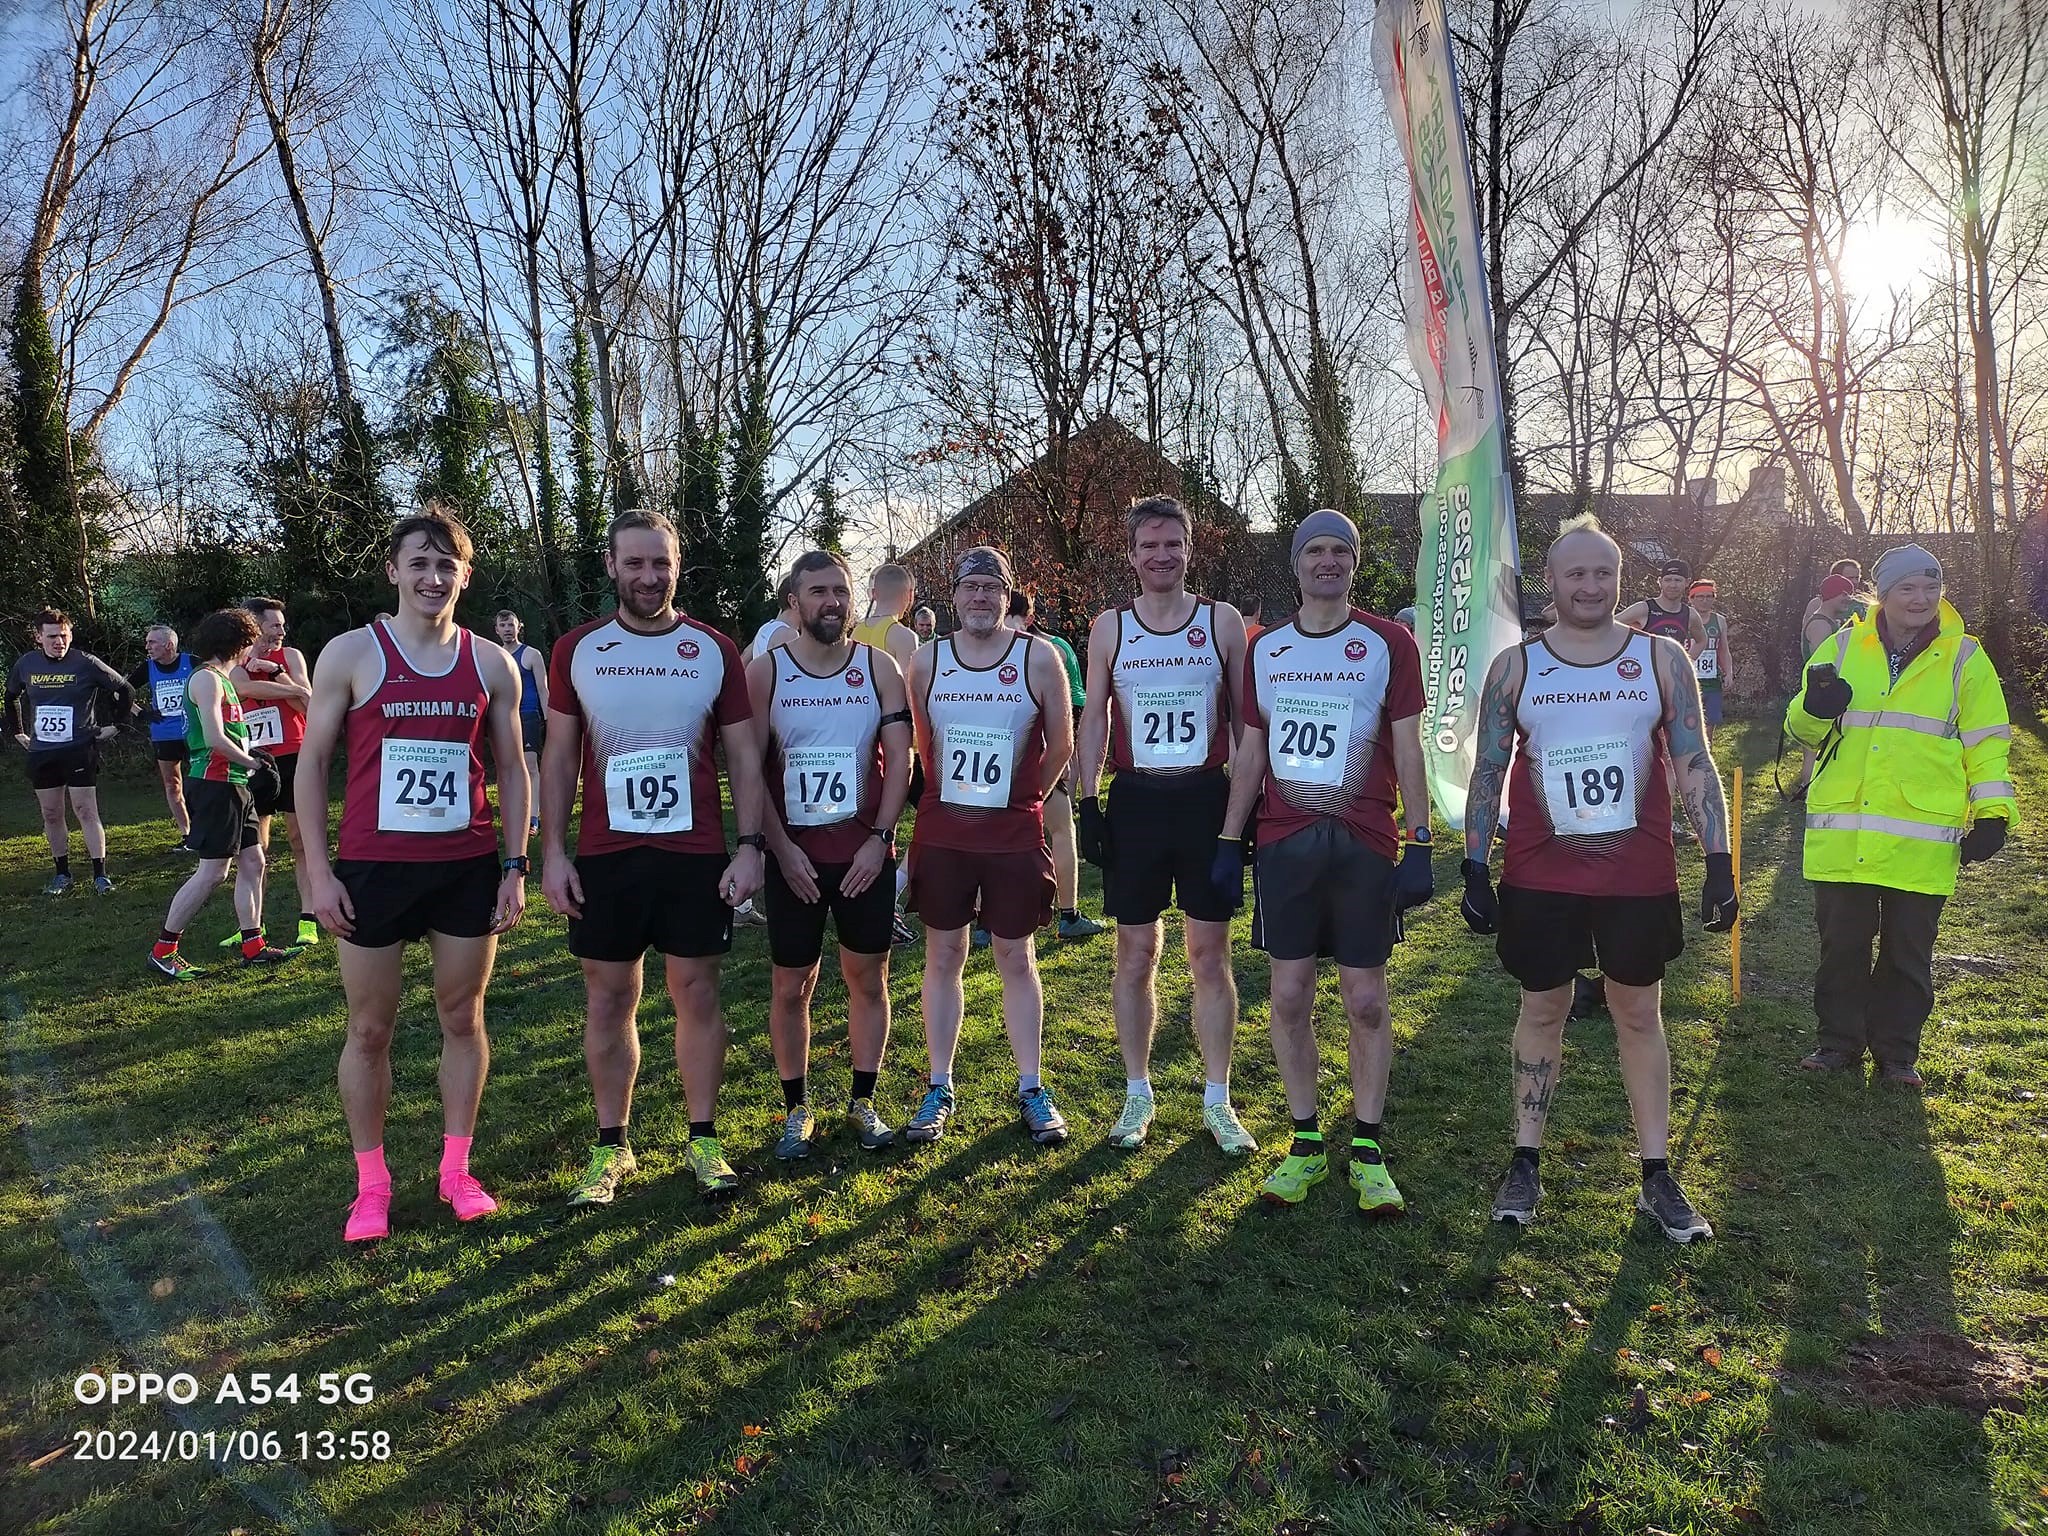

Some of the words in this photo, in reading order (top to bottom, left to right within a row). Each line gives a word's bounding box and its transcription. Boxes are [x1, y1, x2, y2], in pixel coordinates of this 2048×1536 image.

[1122, 657, 1184, 670] WREXHAM
[1187, 656, 1213, 666] AAC
[31, 674, 76, 684] RUN-FREE
[595, 666, 666, 677] WREXHAM
[670, 667, 699, 679] AAC
[1269, 672, 1333, 683] WREXHAM
[1337, 672, 1366, 682] AAC
[781, 697, 842, 708] WREXHAM
[845, 695, 870, 705] AAC
[934, 693, 993, 702] WREXHAM
[997, 693, 1022, 703] AAC
[1137, 691, 1175, 699] GRAND
[1532, 690, 1611, 706] WREXHAM
[1616, 690, 1648, 702] AAC
[381, 701, 453, 718] WREXHAM
[1137, 699, 1186, 707] EXPRESS
[1277, 697, 1318, 707] GRAND
[1321, 702, 1349, 710] PRIX
[1276, 706, 1329, 717] EXPRESS
[41, 717, 67, 732] 255
[1143, 711, 1196, 744] 215
[947, 728, 984, 738] GRAND
[986, 732, 1012, 741] PRIX
[1278, 719, 1337, 759] 205
[947, 737, 994, 747] EXPRESS
[389, 745, 437, 755] GRAND
[439, 748, 466, 757] PRIX
[1548, 745, 1594, 758] GRAND
[1597, 740, 1628, 751] PRIX
[388, 754, 448, 763] EXPRESS
[613, 755, 654, 767] GRAND
[657, 752, 684, 762] PRIX
[788, 752, 825, 760] GRAND
[1548, 753, 1609, 767] EXPRESS
[612, 762, 667, 773] EXPRESS
[951, 749, 1001, 785] 216
[395, 768, 457, 806] 254
[625, 774, 679, 810] 195
[800, 771, 847, 803] 176
[1564, 765, 1625, 809] 189
